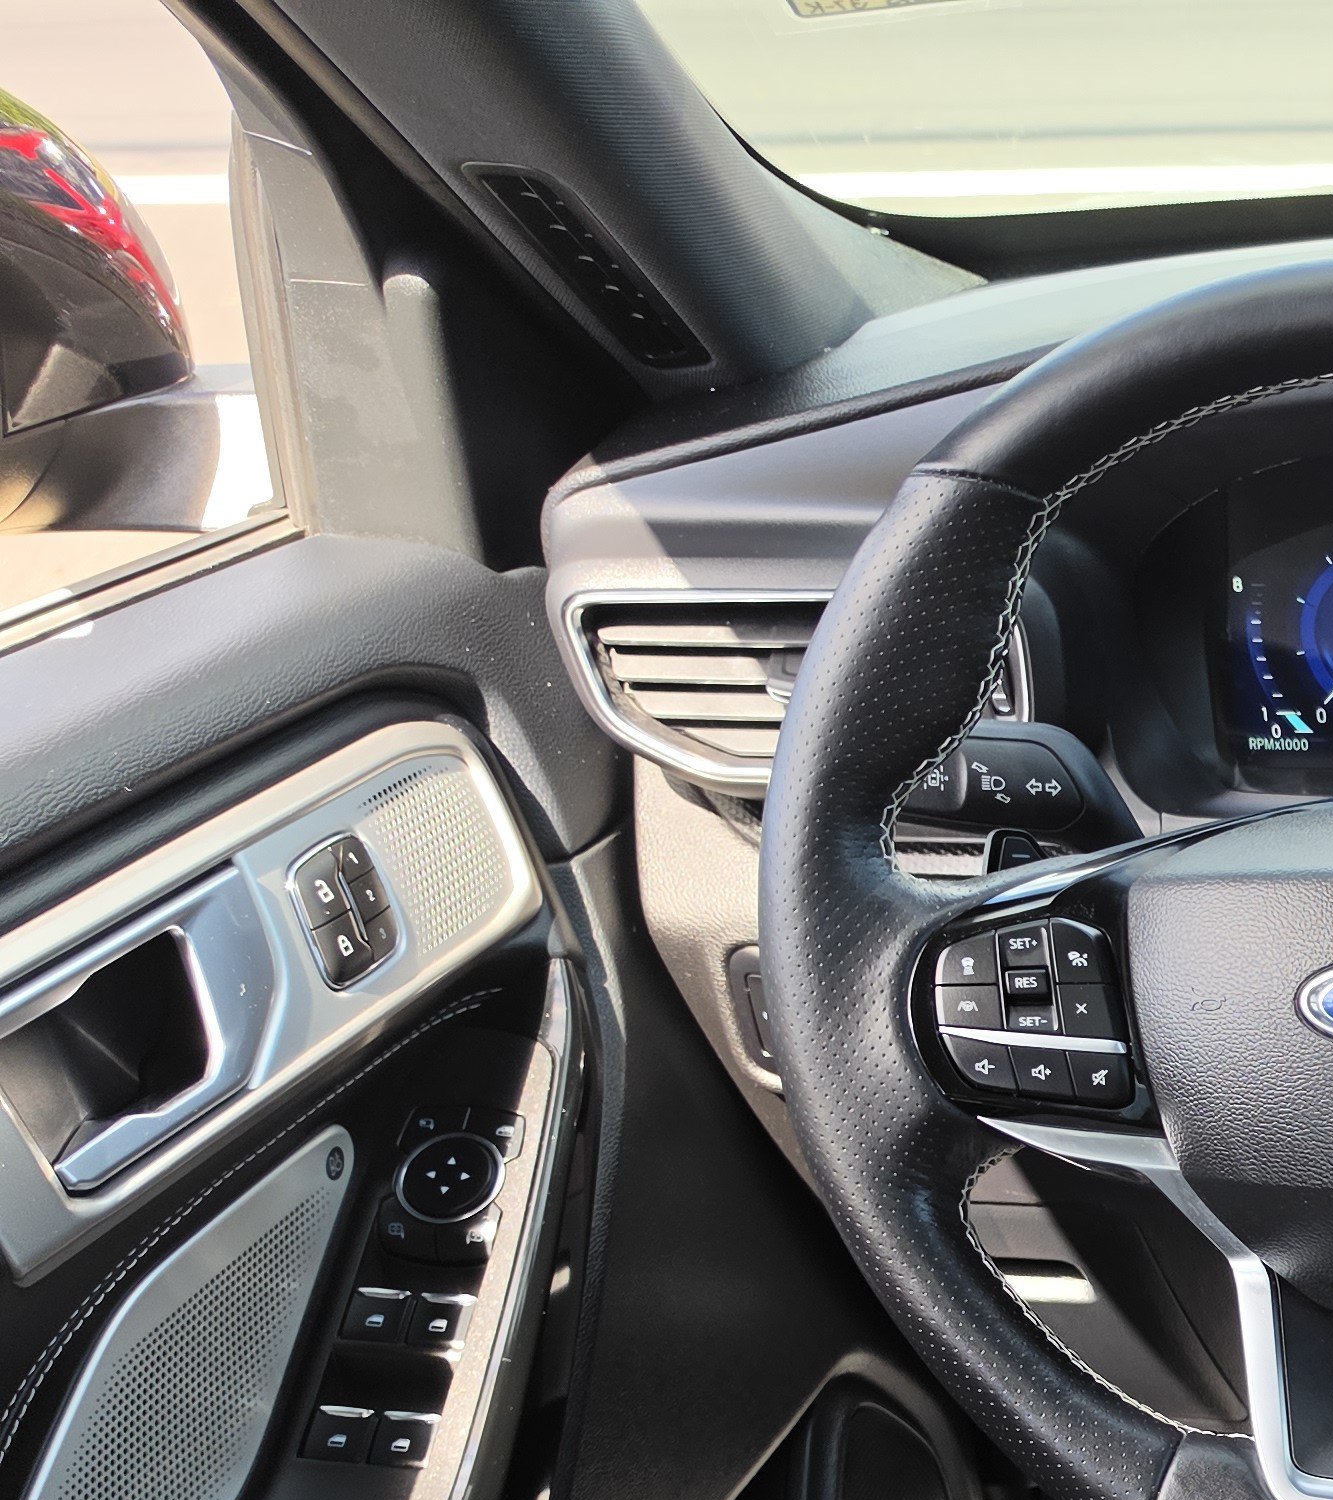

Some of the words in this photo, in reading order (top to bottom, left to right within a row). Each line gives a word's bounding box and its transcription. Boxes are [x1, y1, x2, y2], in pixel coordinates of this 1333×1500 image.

[1261, 706, 1268, 722] 1
[1315, 707, 1327, 724] 0
[1271, 724, 1282, 738] 0
[1248, 737, 1309, 751] RPMx1000
[1014, 976, 1038, 989] RES
